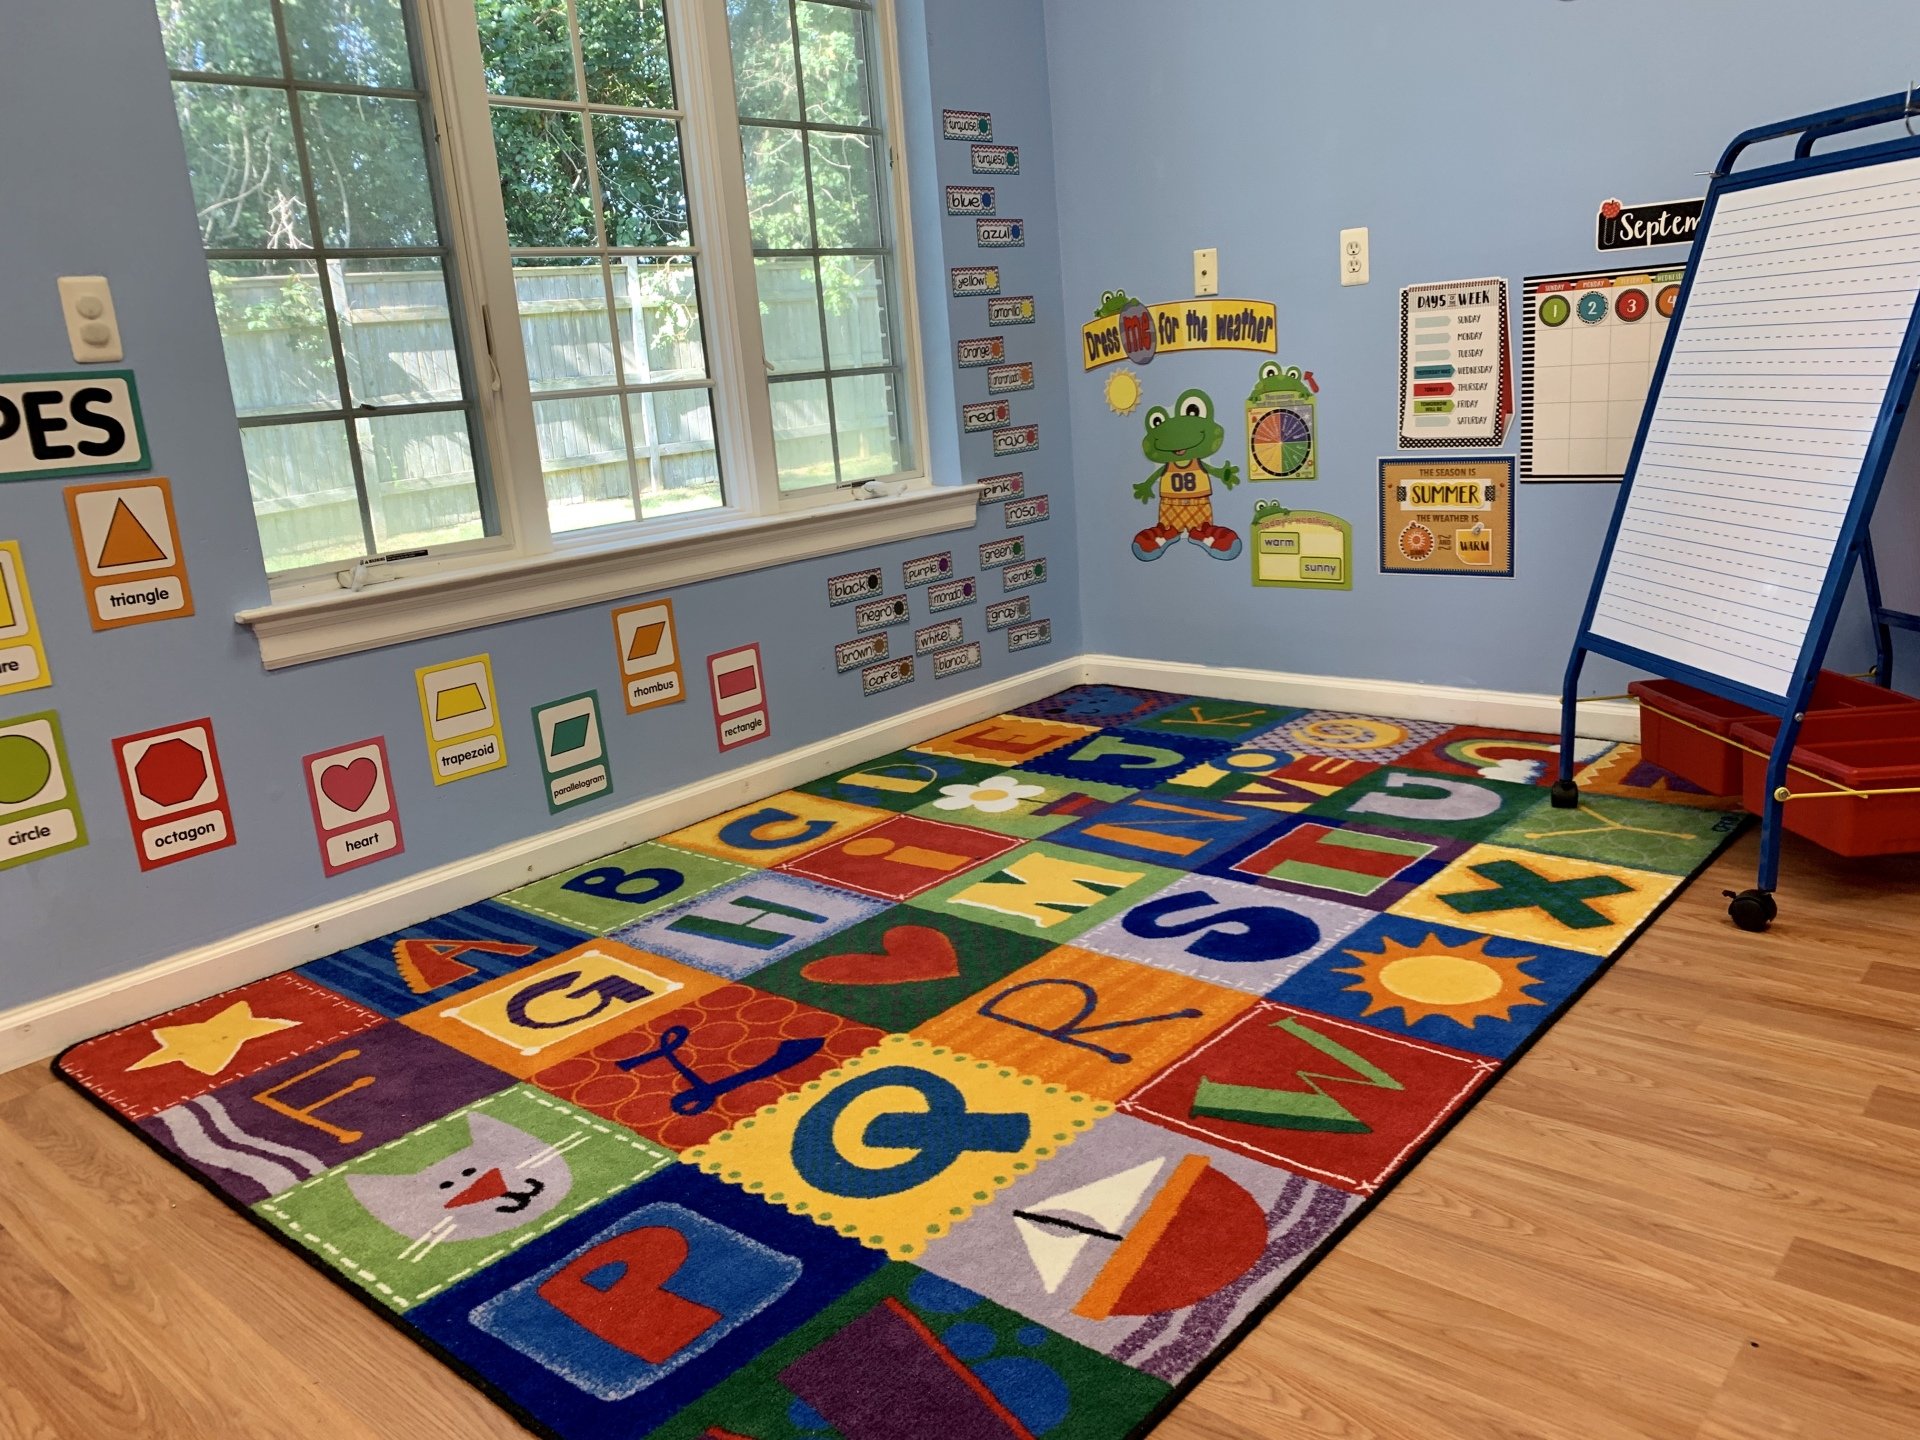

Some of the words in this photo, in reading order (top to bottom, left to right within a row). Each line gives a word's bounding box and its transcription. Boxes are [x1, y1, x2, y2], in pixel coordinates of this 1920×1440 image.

[949, 119, 977, 133] turquoise
[977, 154, 1005, 166] turquesa
[952, 194, 980, 208] blue
[982, 225, 1010, 240] azul
[958, 275, 985, 289] yellow
[1545, 284, 1564, 292] SUNDAY
[1418, 294, 1446, 308] DAYS
[1458, 290, 1490, 306] WEEK
[1553, 305, 1557, 317] 1
[1588, 301, 1597, 314] 2
[1626, 299, 1637, 313] 3
[1667, 295, 1676, 308] 4
[1457, 314, 1481, 324] SUNDAY
[1085, 326, 1121, 361] Dress
[1123, 312, 1151, 353] me
[1158, 312, 1180, 345] for
[1185, 309, 1208, 343] the
[1216, 308, 1273, 344] weather
[1457, 331, 1483, 341] MONDAY
[963, 346, 989, 359] orange
[1458, 349, 1484, 358] TUESDAY
[1457, 365, 1493, 375] WEDNESDAY
[1457, 383, 1488, 391] THURSDAY
[1457, 400, 1479, 408] FRIDAY
[968, 410, 995, 423] red
[1457, 416, 1487, 425] SATURDAY
[998, 433, 1025, 447] rojo
[1420, 469, 1434, 477] THE
[1436, 468, 1466, 477] SEASON
[1469, 468, 1476, 476] IS
[983, 481, 1010, 498] pink
[1171, 472, 1196, 492] 08
[1412, 485, 1479, 504] SUMMER
[1009, 504, 1036, 519] rosa
[1417, 514, 1431, 522] THE
[1264, 539, 1294, 547] warm
[1460, 541, 1489, 551] WARM
[984, 547, 1012, 563] green
[908, 564, 937, 580] purple
[1007, 568, 1033, 583] verde
[1305, 563, 1336, 575] sunny
[110, 588, 169, 607] triangle
[834, 580, 866, 597] black
[933, 588, 961, 604] morado
[861, 606, 892, 623] negro
[992, 607, 1016, 622] gray
[921, 630, 949, 648] white
[1012, 630, 1038, 645] gris
[842, 644, 873, 664] brown
[939, 654, 966, 671] blanco
[868, 667, 898, 687] café
[634, 680, 674, 697] rhombus
[724, 717, 762, 737] rectangle
[953, 726, 1070, 754] E
[442, 743, 494, 767] trapezoid
[1067, 735, 1185, 769] J
[553, 774, 605, 798] parallelogram
[836, 763, 938, 793] D
[1346, 772, 1502, 821] U
[8, 825, 51, 846] circle
[155, 822, 216, 848] octagon
[719, 808, 838, 850] C
[1081, 799, 1248, 857] N
[346, 833, 379, 852] heart
[562, 867, 684, 904] B
[946, 852, 1147, 928] M
[1436, 859, 1635, 929] X
[666, 895, 828, 951] H
[1122, 891, 1320, 962] S
[393, 939, 538, 994] A
[507, 971, 654, 1029] G
[977, 979, 1203, 1064] R
[615, 1025, 826, 1115] L
[1190, 1016, 1405, 1134] W
[253, 1049, 376, 1144] F
[791, 1065, 1031, 1199] Q
[538, 1226, 721, 1364] P
